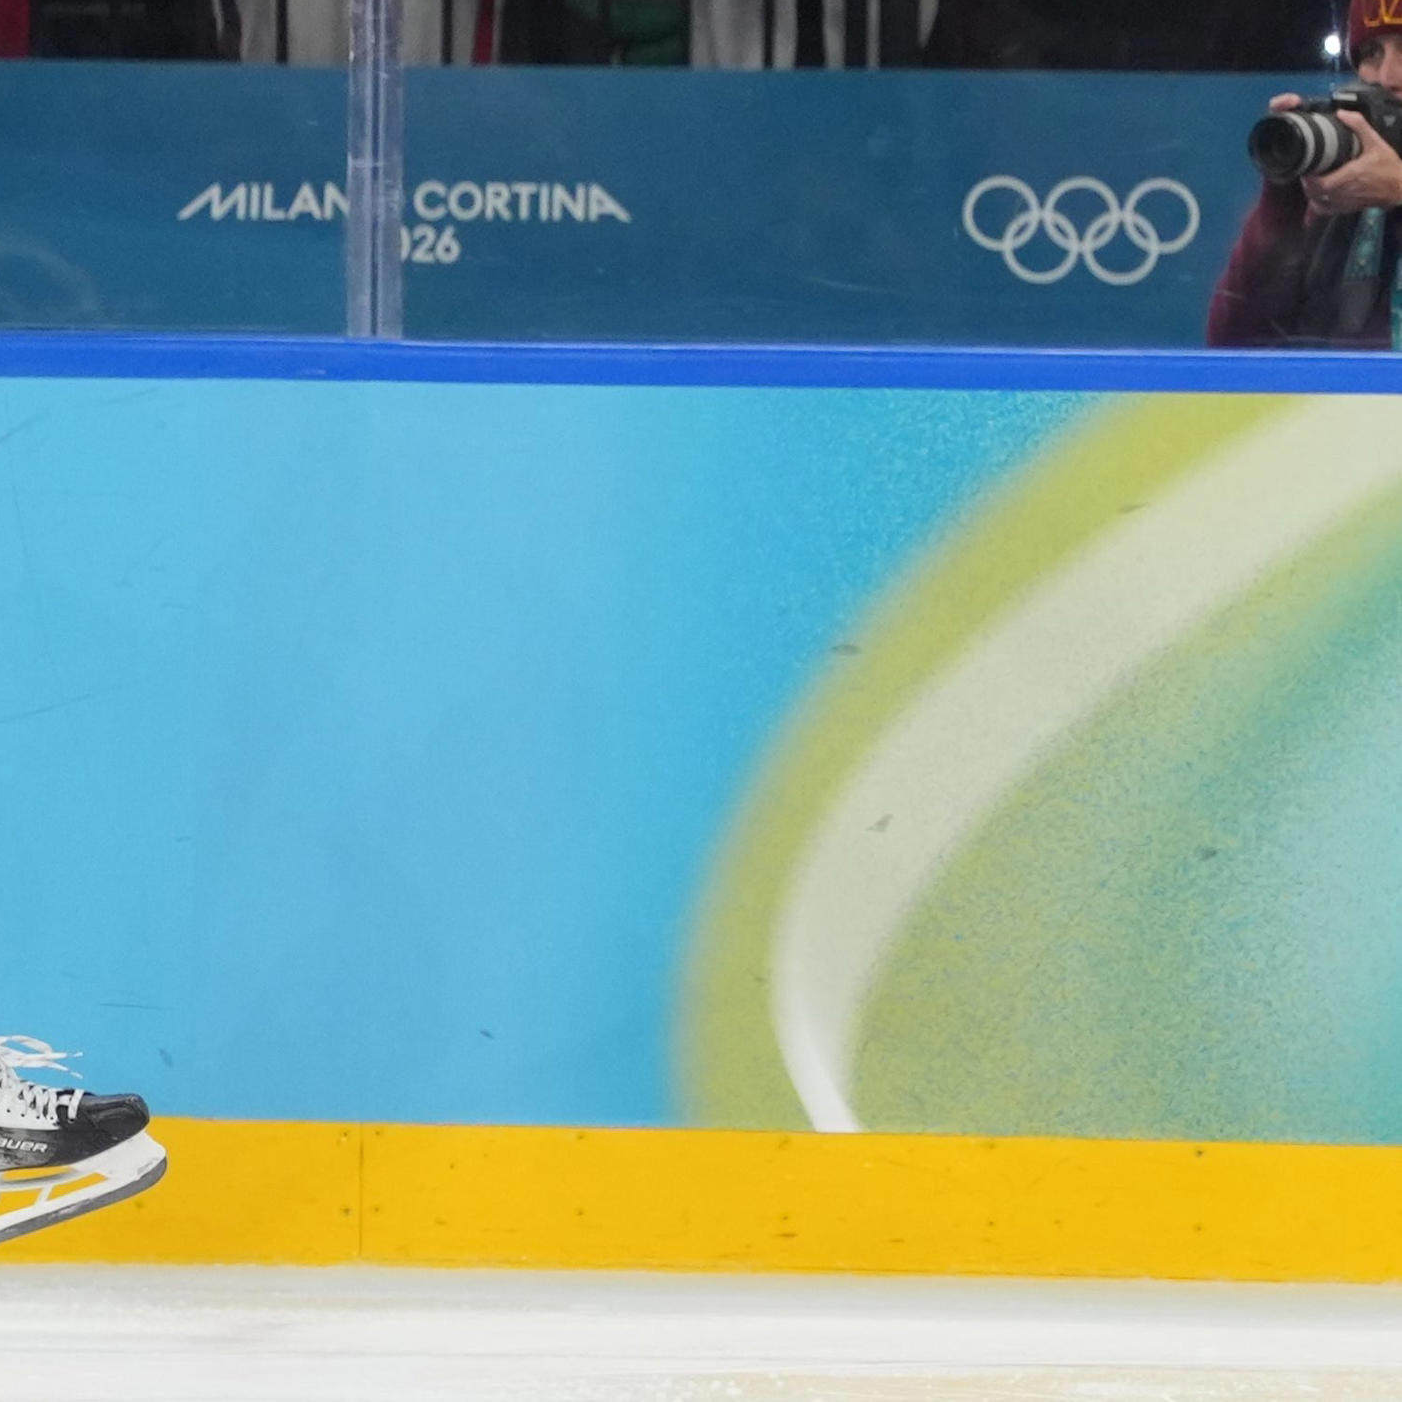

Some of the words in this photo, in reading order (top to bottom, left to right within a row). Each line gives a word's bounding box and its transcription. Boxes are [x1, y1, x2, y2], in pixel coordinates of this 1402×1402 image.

[176, 181, 351, 222] MILAN
[413, 180, 632, 223] CORTINA
[401, 224, 461, 264] 26
